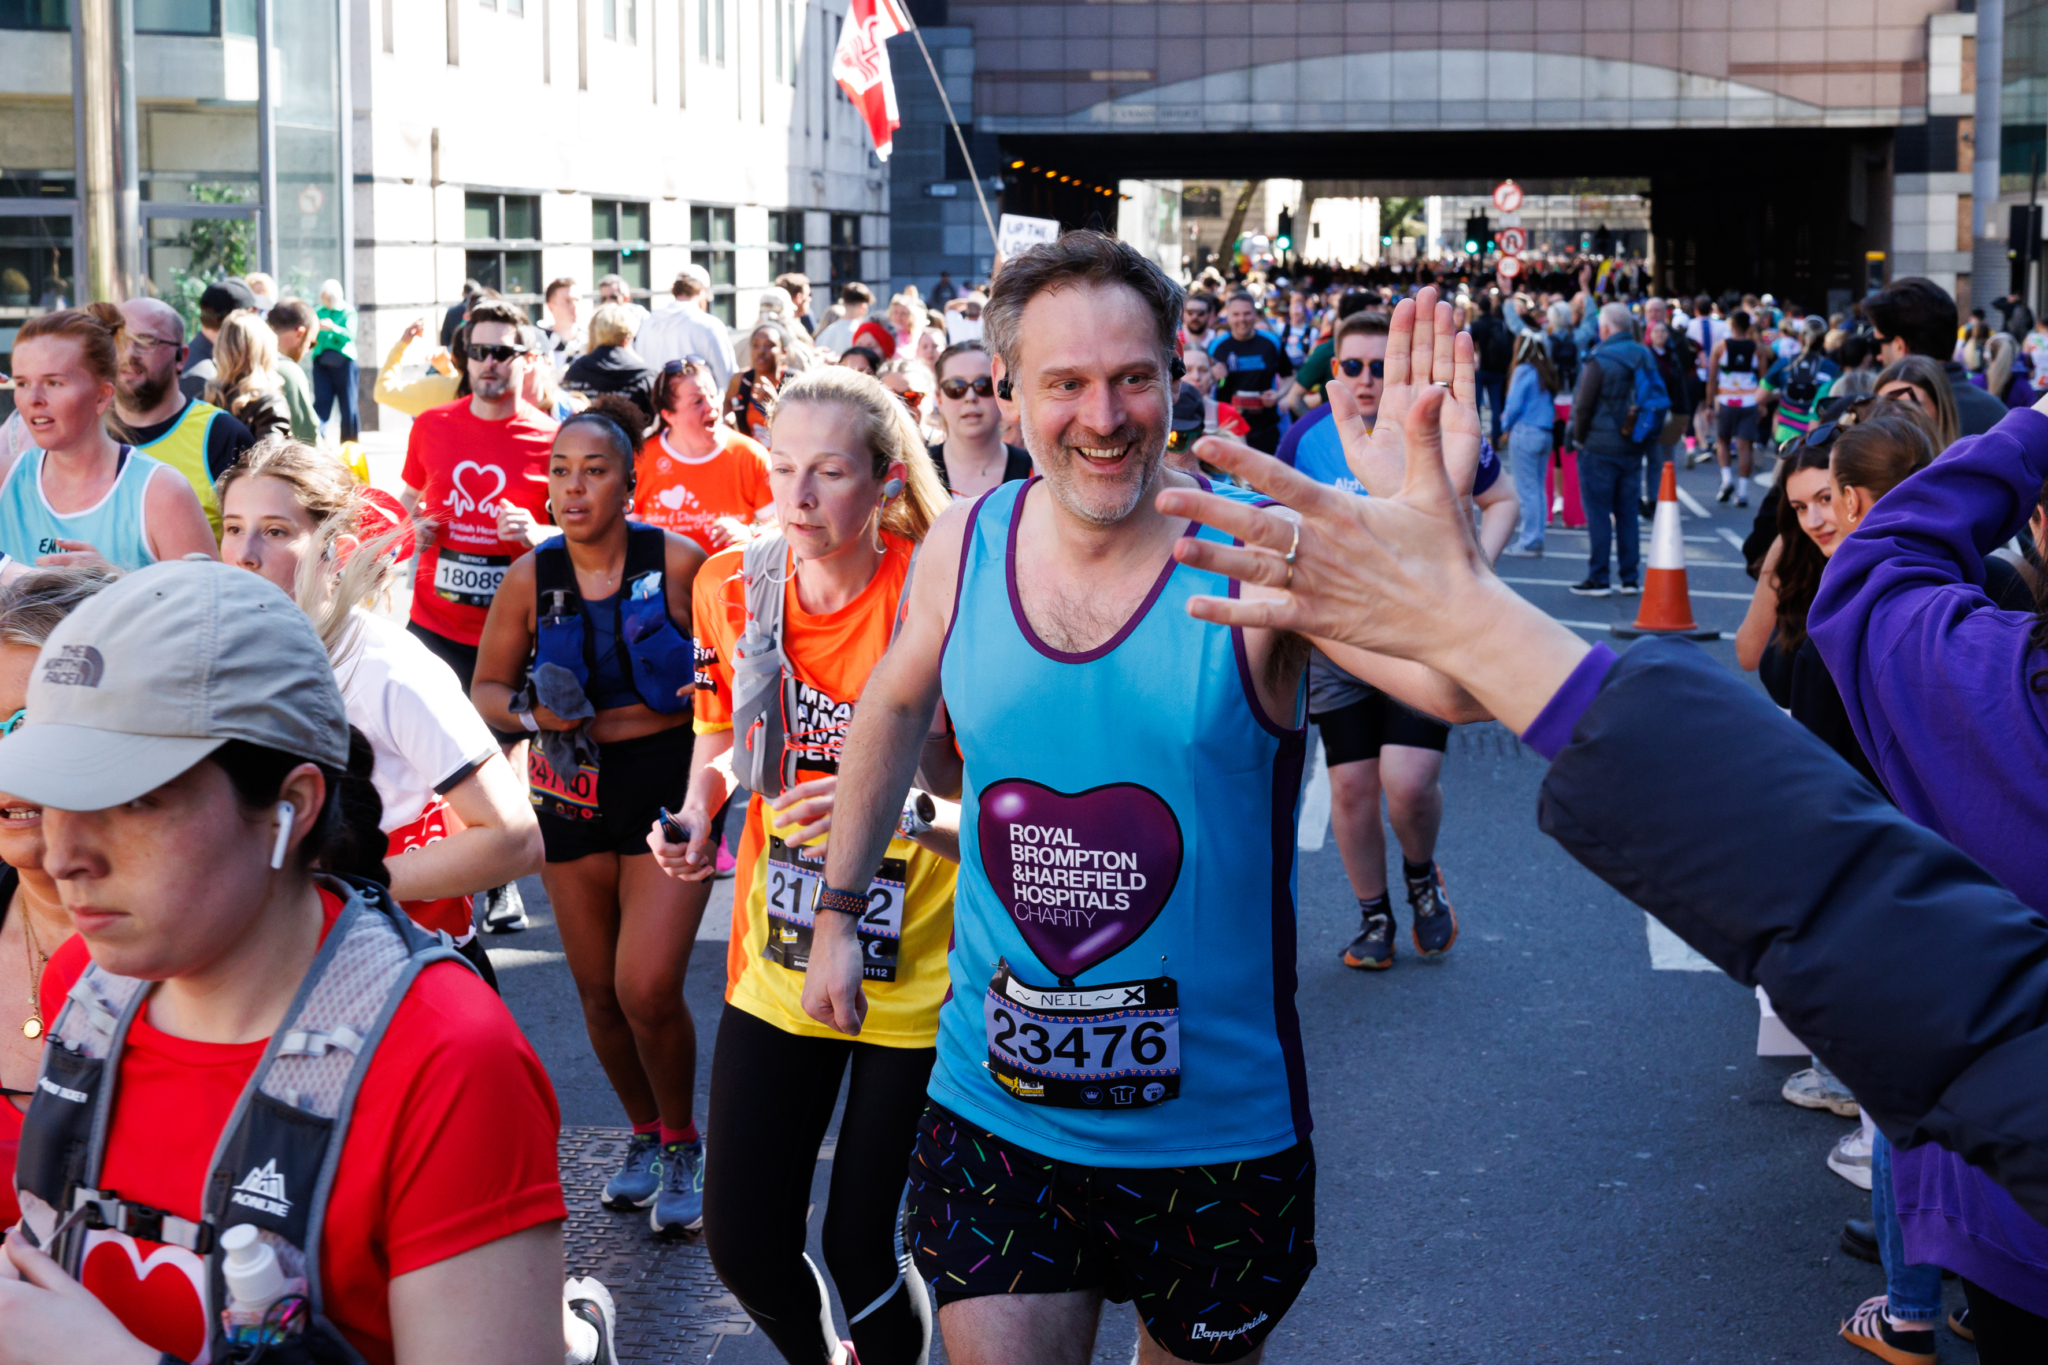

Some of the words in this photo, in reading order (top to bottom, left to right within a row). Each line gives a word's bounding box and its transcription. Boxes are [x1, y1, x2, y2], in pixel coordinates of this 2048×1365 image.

[38, 538, 71, 554] EM
[449, 531, 498, 545] Foundation
[442, 566, 505, 590] 18089
[61, 645, 85, 657] THE
[42, 658, 82, 670] NORTH
[43, 671, 77, 685] FACE
[1009, 823, 1081, 848] ROYAL
[1010, 843, 1138, 871] BROMPTON
[1012, 863, 1147, 891] &HAREFIELD
[1013, 882, 1131, 911] HOSPITALS
[1014, 902, 1097, 929] CHARITY
[1040, 993, 1092, 1007] NEIL
[993, 1008, 1167, 1066] 23476
[1120, 1090, 1126, 1101] L
